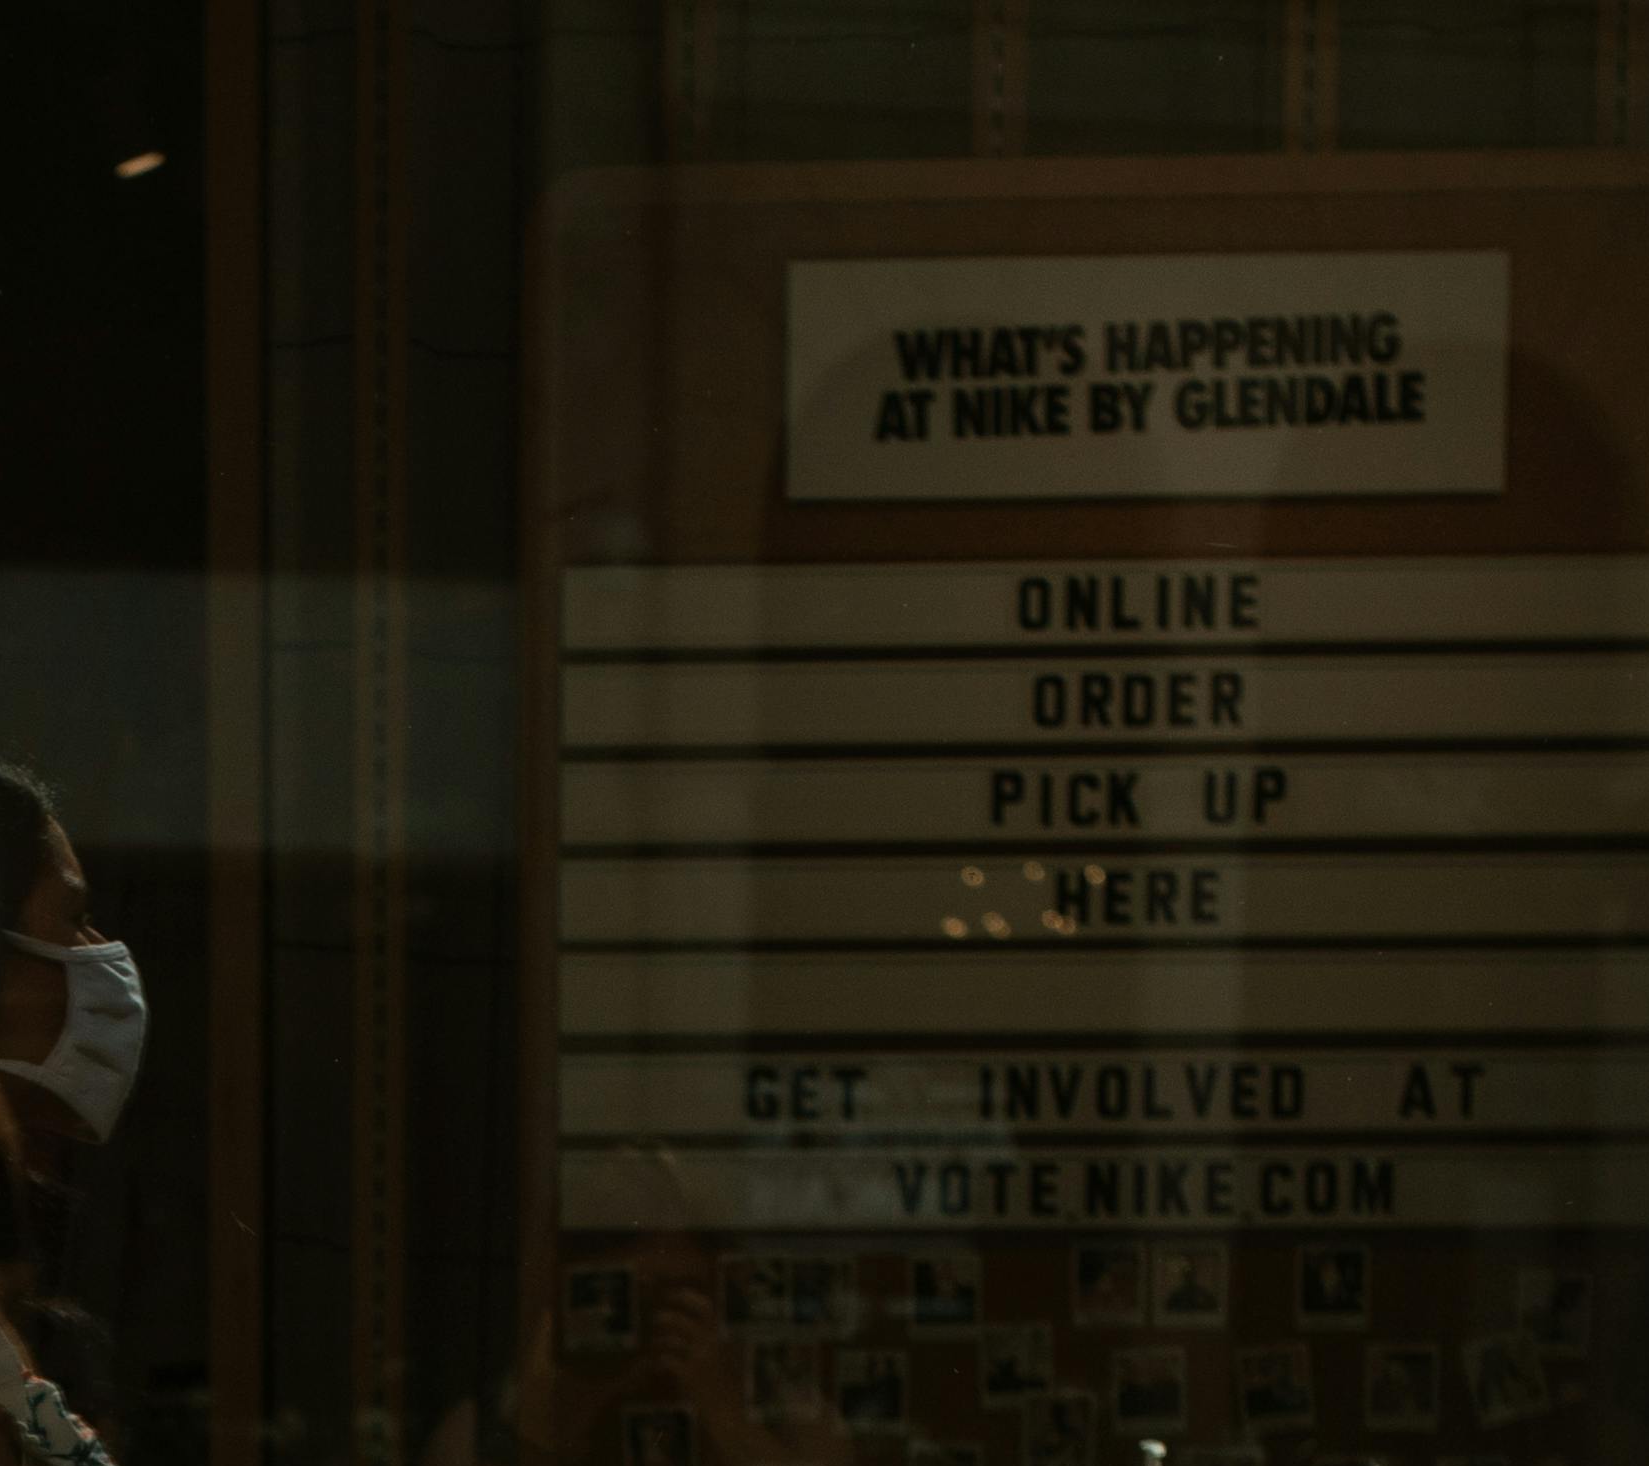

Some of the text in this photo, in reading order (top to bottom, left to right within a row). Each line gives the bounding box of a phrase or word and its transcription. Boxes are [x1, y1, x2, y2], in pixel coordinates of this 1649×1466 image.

[894, 312, 1401, 381] WHAT'S HAPPENING
[875, 371, 1427, 442] AT NIKE BY GLENDALE
[1017, 575, 1259, 630] ONLINE
[1034, 672, 1244, 728] ORDER
[991, 765, 1288, 828] PICK UP
[1054, 869, 1220, 925] HERE
[745, 1064, 1485, 1121] GET INVOLVED AT
